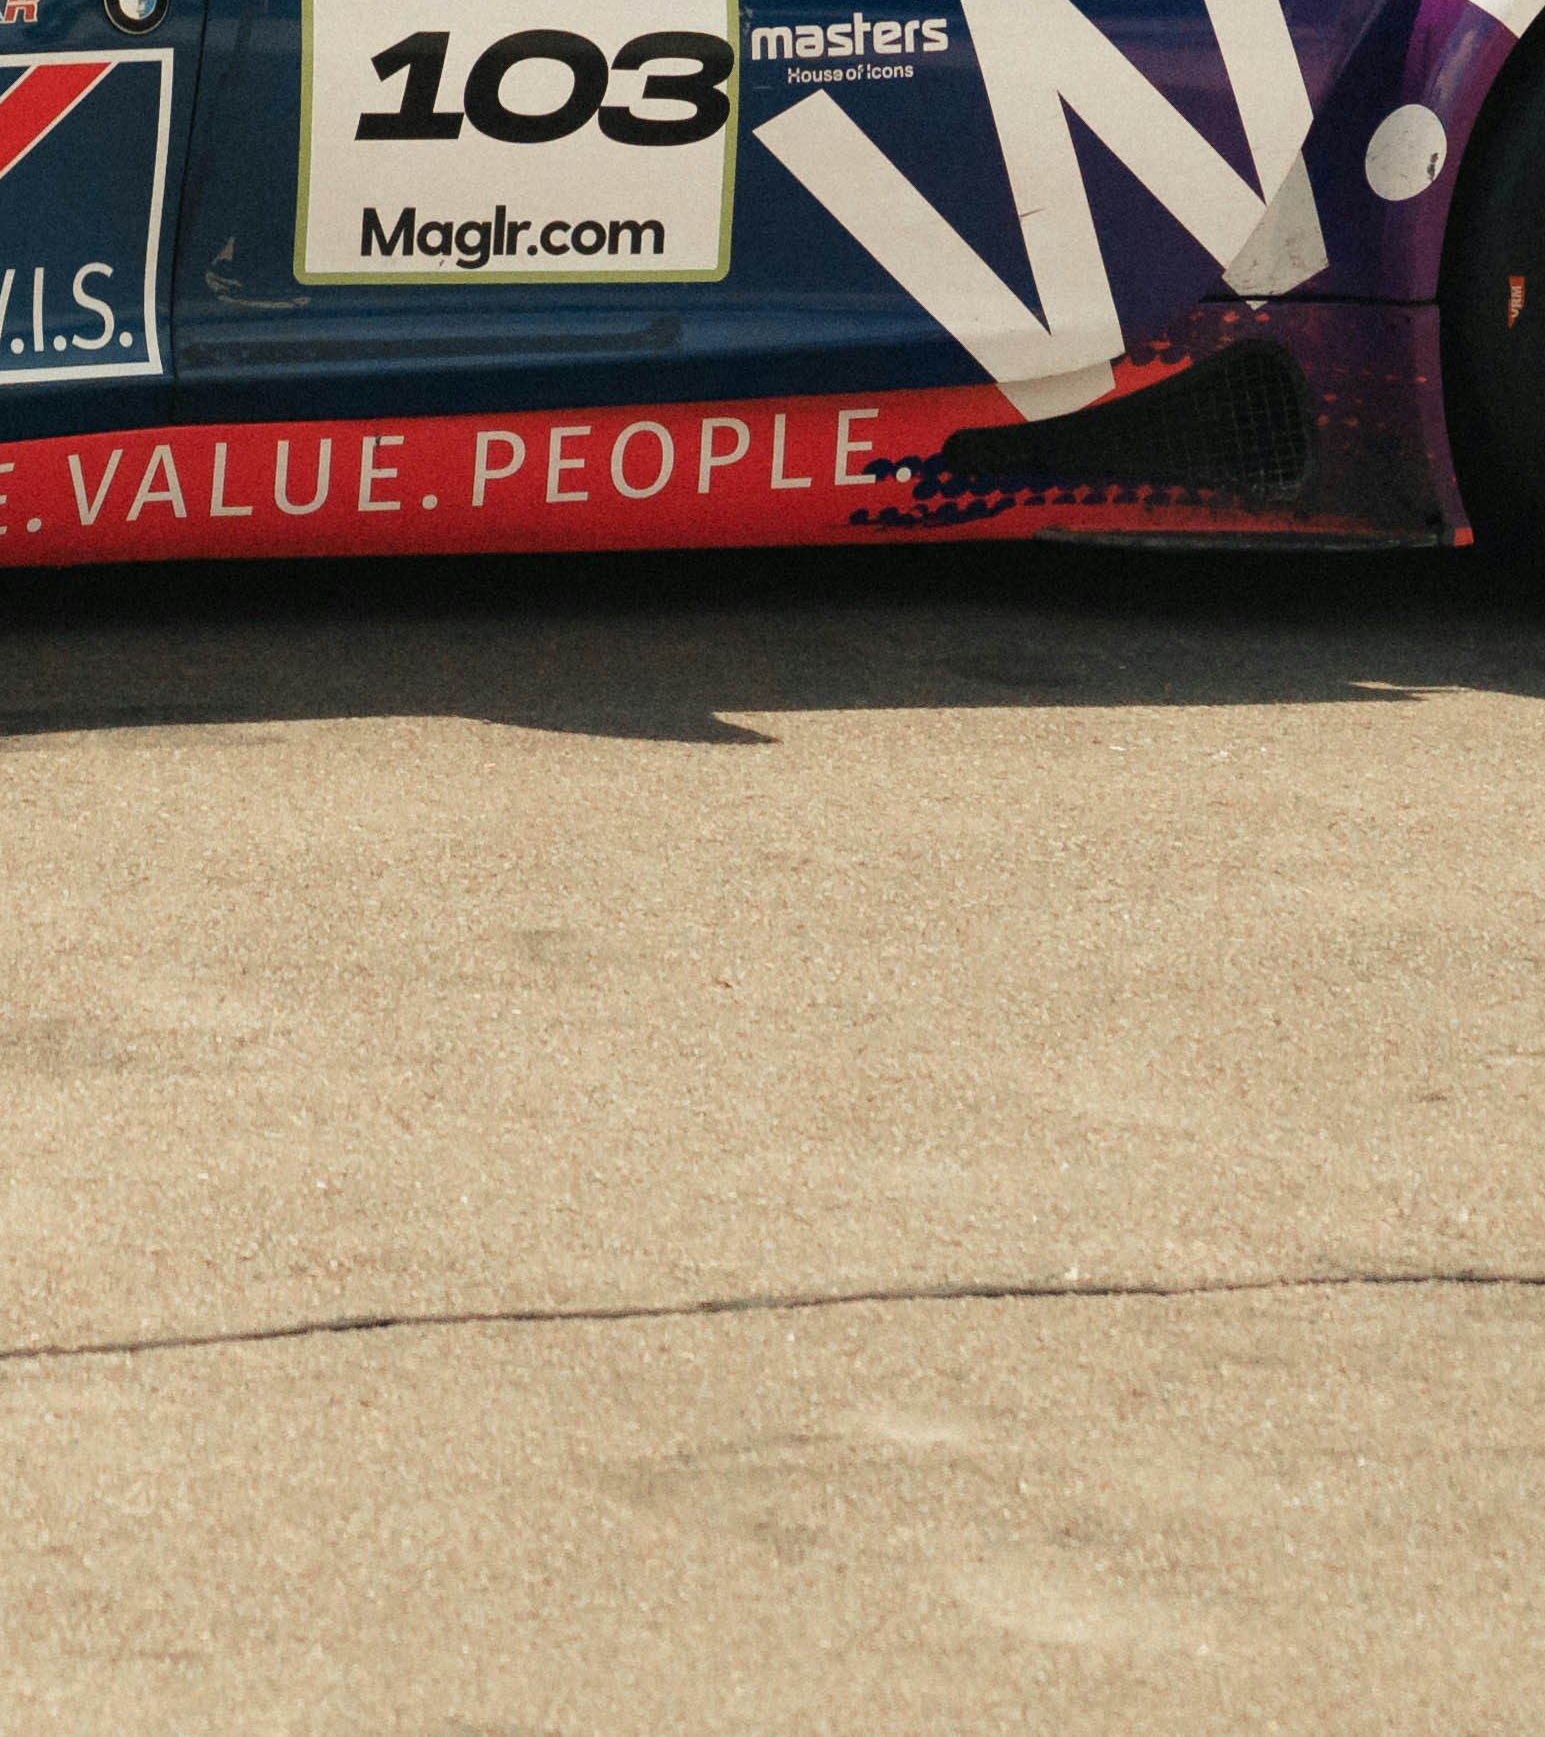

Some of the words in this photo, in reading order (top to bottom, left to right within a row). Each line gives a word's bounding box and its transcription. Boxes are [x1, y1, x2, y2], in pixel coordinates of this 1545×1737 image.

[751, 12, 949, 61] masters
[354, 29, 736, 147] 103
[787, 66, 844, 85] House
[866, 63, 914, 81] Icons
[361, 205, 665, 270] Maglr.com
